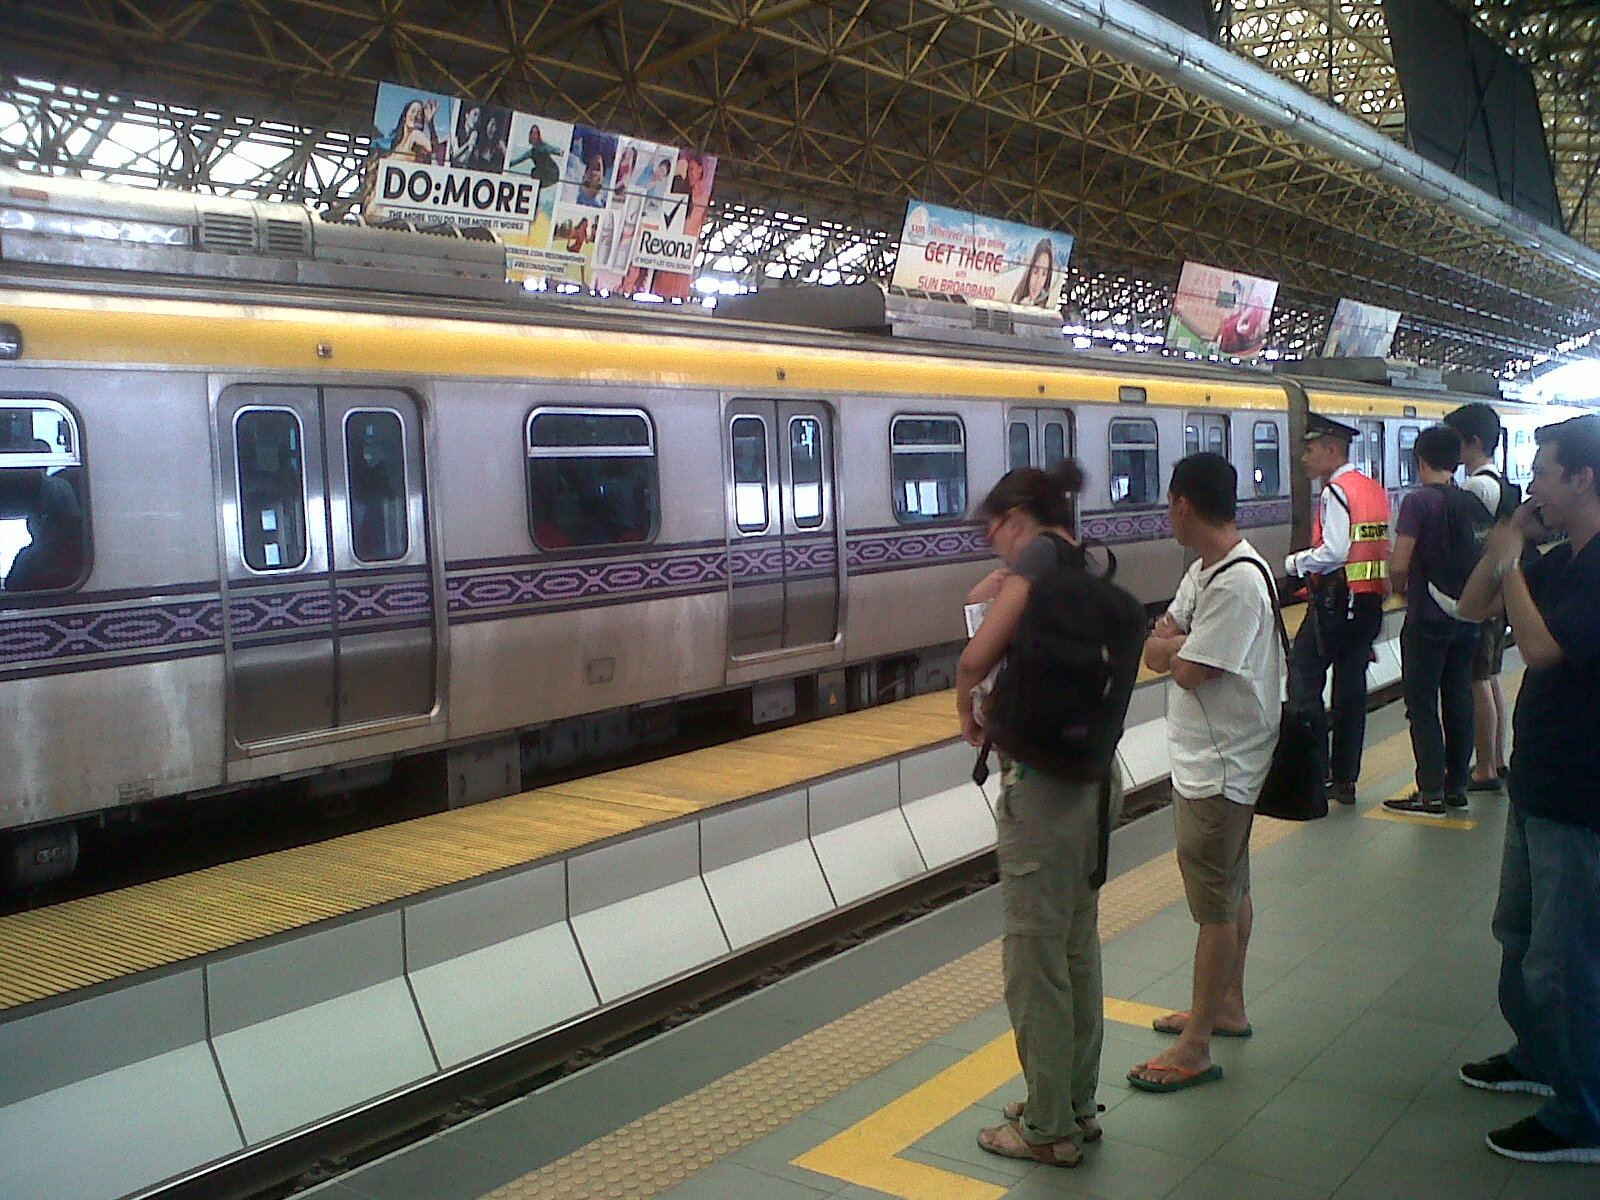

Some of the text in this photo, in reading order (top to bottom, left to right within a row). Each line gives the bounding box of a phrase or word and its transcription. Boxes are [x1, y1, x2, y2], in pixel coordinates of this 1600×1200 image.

[639, 231, 693, 260] Rexona
[925, 241, 1004, 274] GET THERE
[918, 275, 996, 300] SUN BROADBAND
